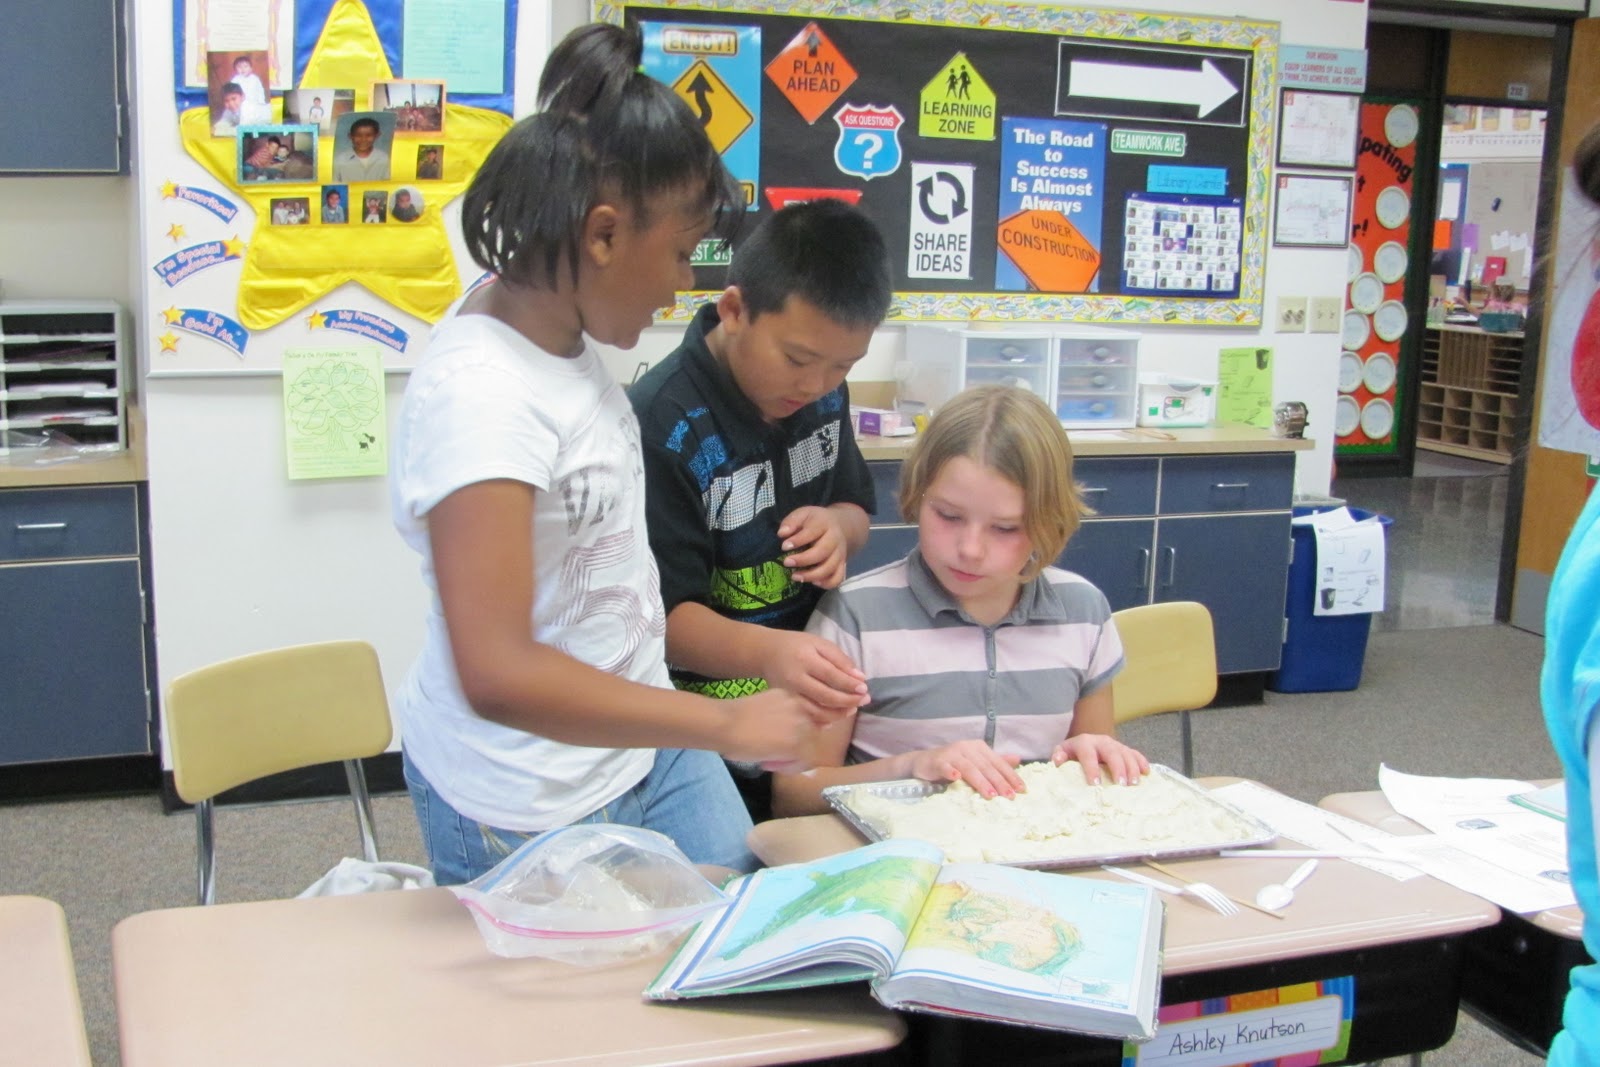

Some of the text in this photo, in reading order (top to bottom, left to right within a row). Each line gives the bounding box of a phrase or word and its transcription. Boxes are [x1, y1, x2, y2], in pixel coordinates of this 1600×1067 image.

[669, 33, 733, 52] ENJOY!
[793, 60, 834, 75] PLAN
[786, 77, 840, 93] AHEAD
[923, 101, 992, 119] LEARNING
[844, 114, 894, 127] ASK QUESTIONS
[938, 119, 975, 134] ZONE
[1013, 128, 1093, 147] The Road
[1115, 133, 1183, 152] TEAMWORK AVE.
[854, 133, 883, 169] ?
[1045, 149, 1062, 162] to
[1016, 160, 1088, 179] Success
[1011, 177, 1093, 197] Is Almost
[1020, 194, 1081, 214] Always
[1031, 217, 1072, 239] UNDER
[914, 232, 967, 251] SHARE
[1002, 229, 1097, 264] CONSTRUCTION
[157, 242, 221, 275] I'm Special
[916, 254, 963, 272] IDEAS
[206, 311, 224, 327] I'm
[338, 310, 353, 321] My
[184, 317, 217, 335] Good
[1168, 1017, 1306, 1056] Ashley Knutson
